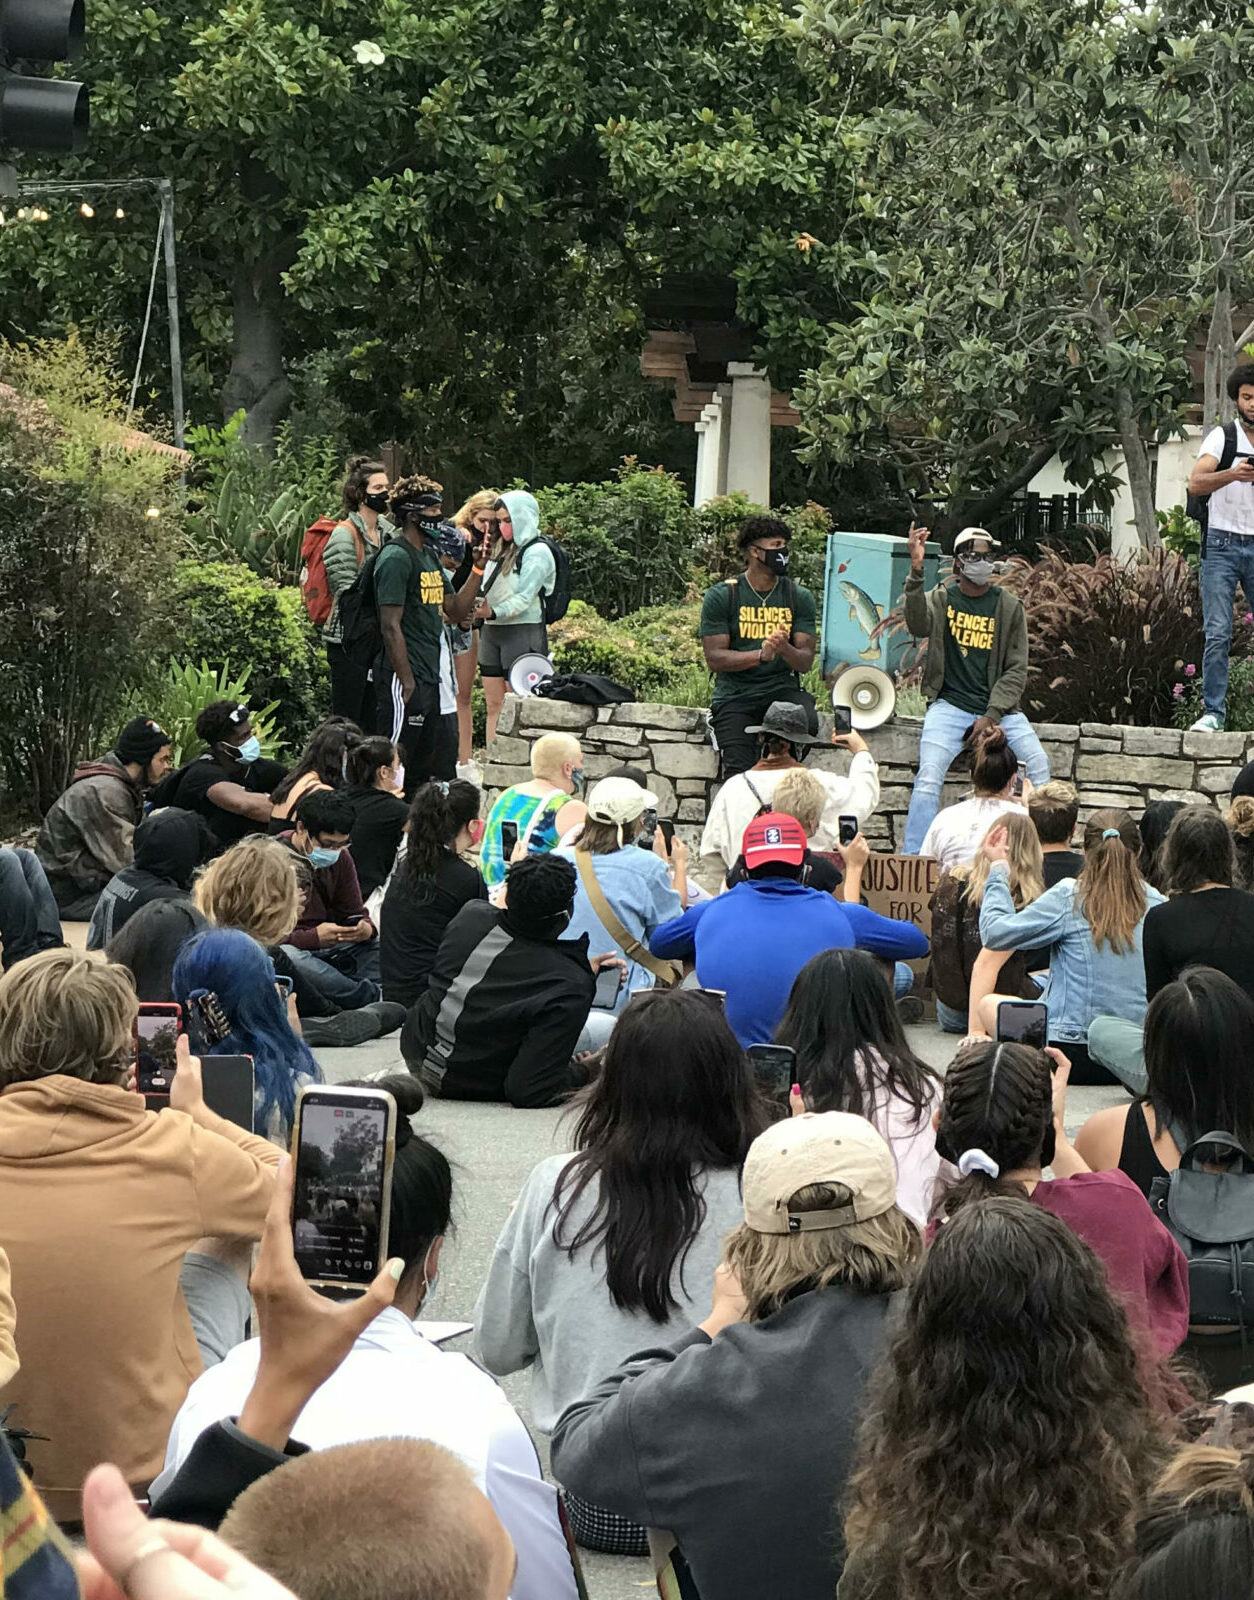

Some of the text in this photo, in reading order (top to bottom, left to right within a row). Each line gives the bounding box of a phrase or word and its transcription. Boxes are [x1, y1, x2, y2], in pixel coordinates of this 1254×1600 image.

[739, 605, 786, 622] SILENCE
[861, 857, 937, 894] JUSTICE
[889, 901, 923, 924] FOR
